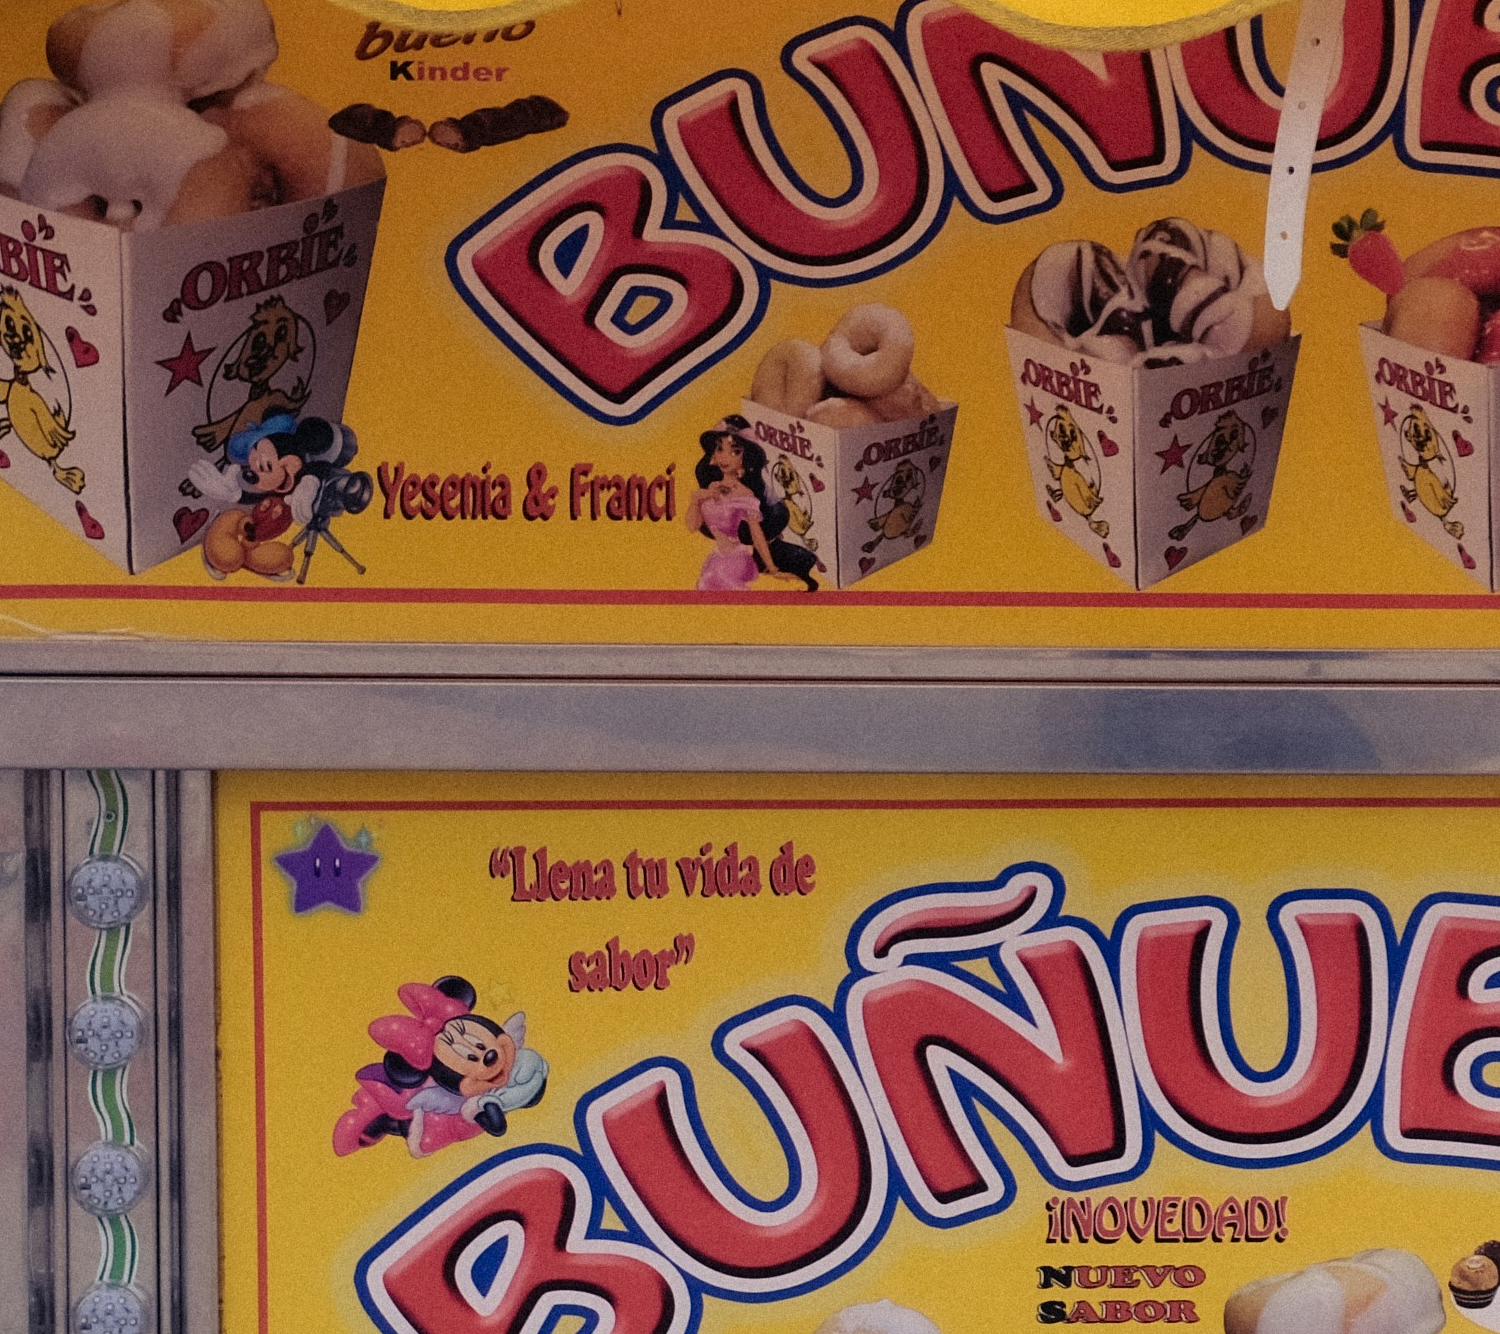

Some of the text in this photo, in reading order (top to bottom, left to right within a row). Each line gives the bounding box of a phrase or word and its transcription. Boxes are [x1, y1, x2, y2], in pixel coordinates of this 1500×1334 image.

[389, 60, 510, 82] Kinder
[181, 212, 345, 310] ORBIE
[1378, 357, 1459, 413] ORBIE
[377, 461, 676, 521] Yesenia & Franci
[622, 849, 670, 899] tu
[675, 841, 762, 898] vida
[770, 840, 816, 896] de
[1045, 1195, 1290, 1244] ¡NOVEDAD!
[1036, 1264, 1206, 1289] NUEVO
[1036, 1299, 1200, 1324] SABOR
